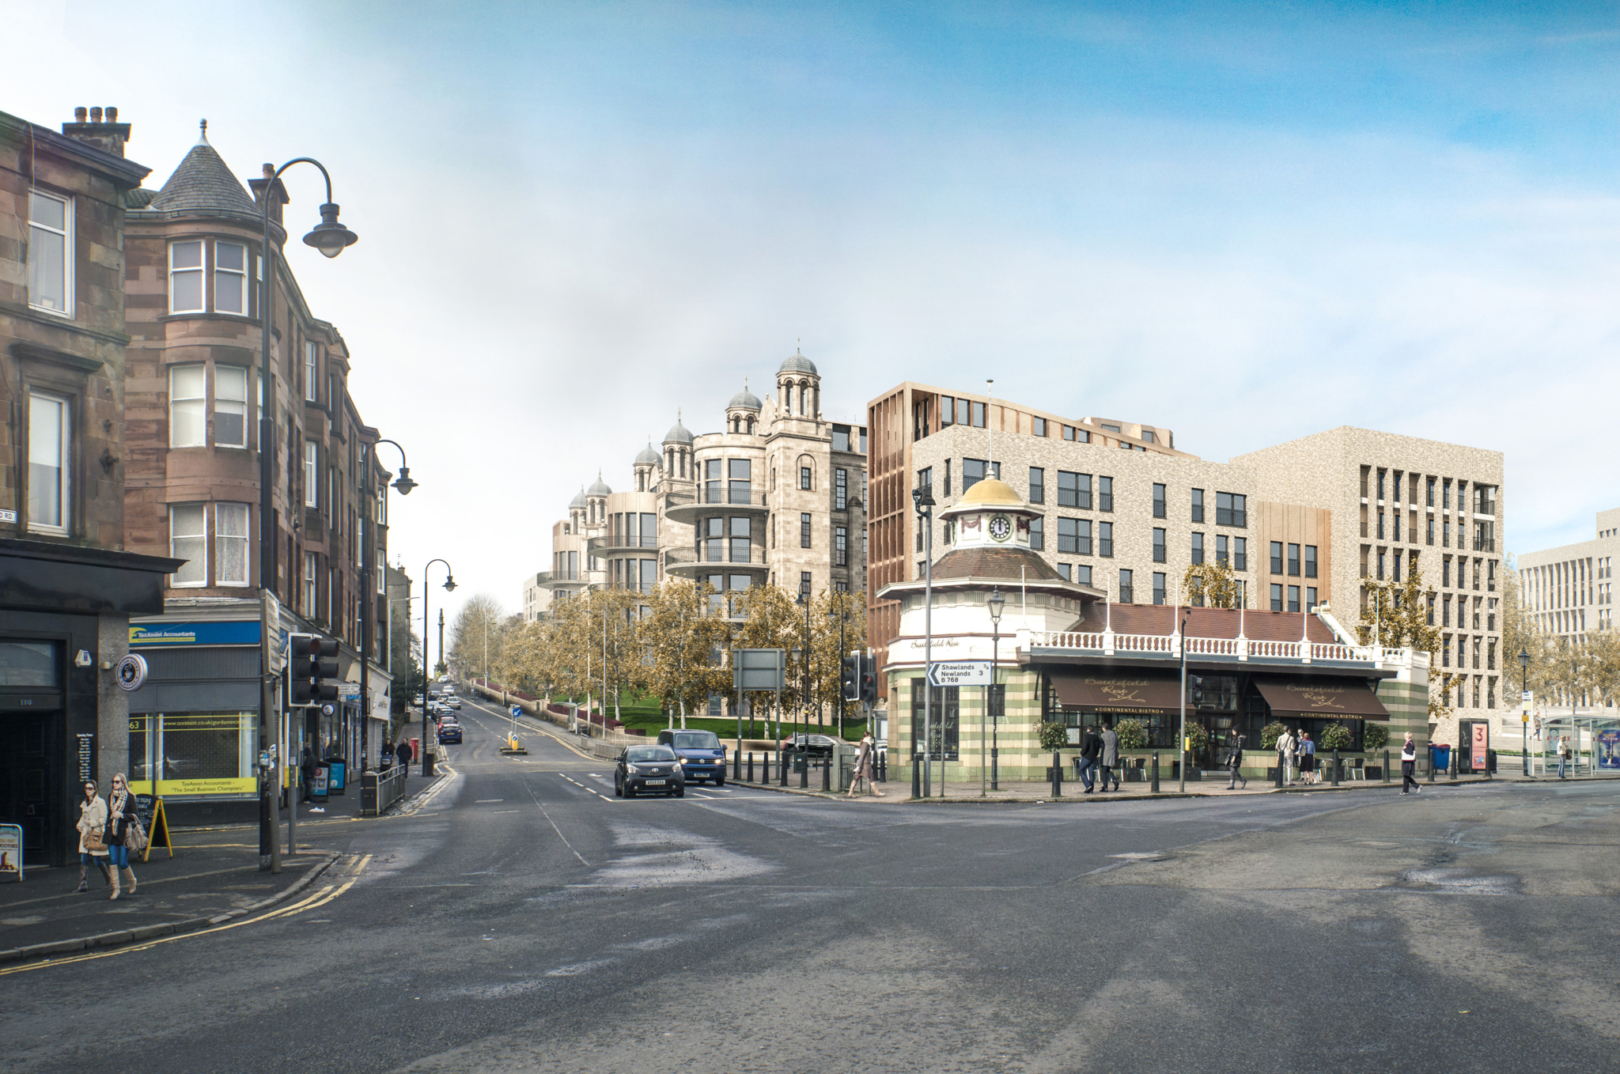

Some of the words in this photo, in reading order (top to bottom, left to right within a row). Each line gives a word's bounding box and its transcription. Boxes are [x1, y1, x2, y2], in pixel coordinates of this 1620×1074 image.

[911, 639, 944, 649] Battfield
[1085, 677, 1150, 688] Battlefield
[1101, 686, 1128, 694] Rest
[1287, 683, 1345, 694] Battlefield
[1302, 692, 1326, 700] Rest
[129, 721, 140, 730] 63
[1475, 727, 1484, 742] 3
